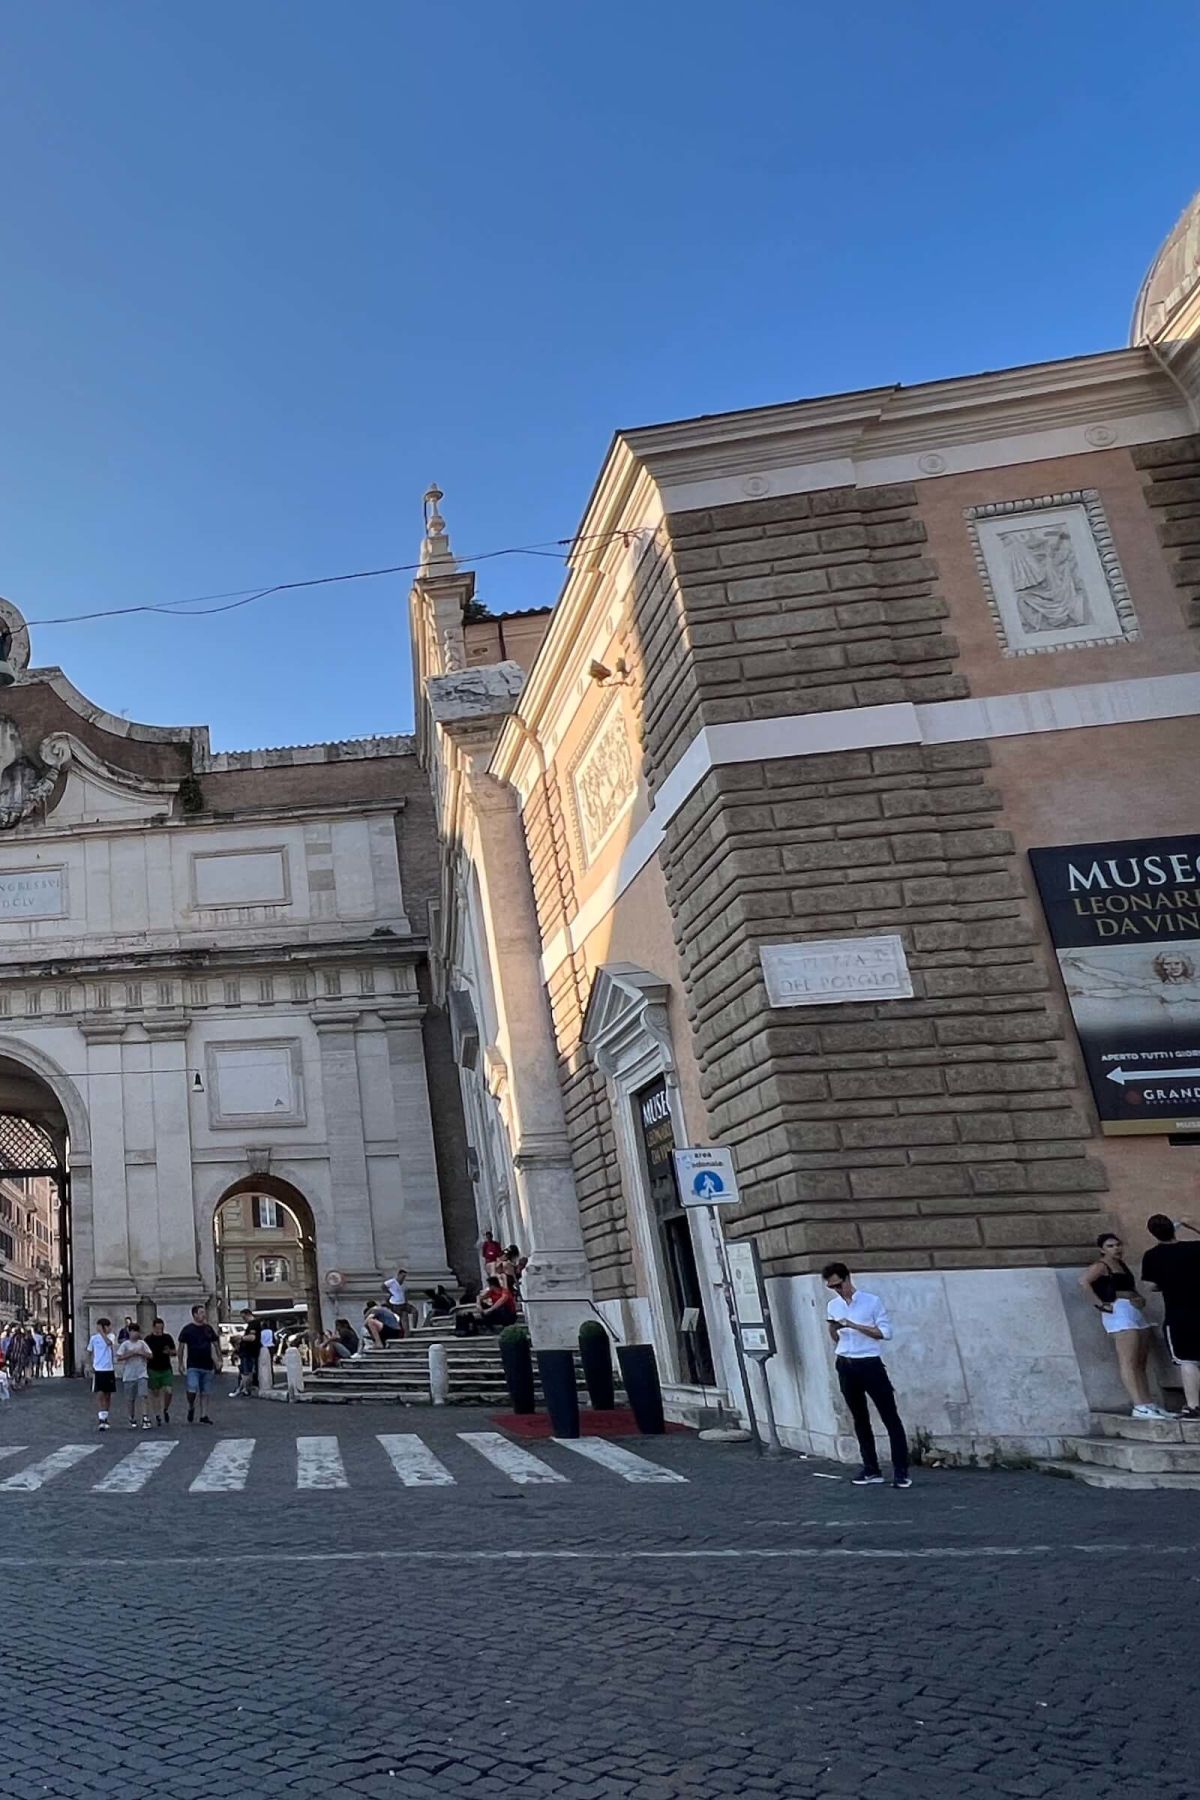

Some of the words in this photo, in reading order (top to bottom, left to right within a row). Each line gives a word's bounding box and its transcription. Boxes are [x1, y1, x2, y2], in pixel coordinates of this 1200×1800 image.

[1068, 854, 1200, 891] MUSE
[1096, 917, 1140, 936] DA
[803, 953, 867, 969] PIZZA
[1101, 1052, 1139, 1061] APERTO
[1140, 1051, 1168, 1060] TUTTI
